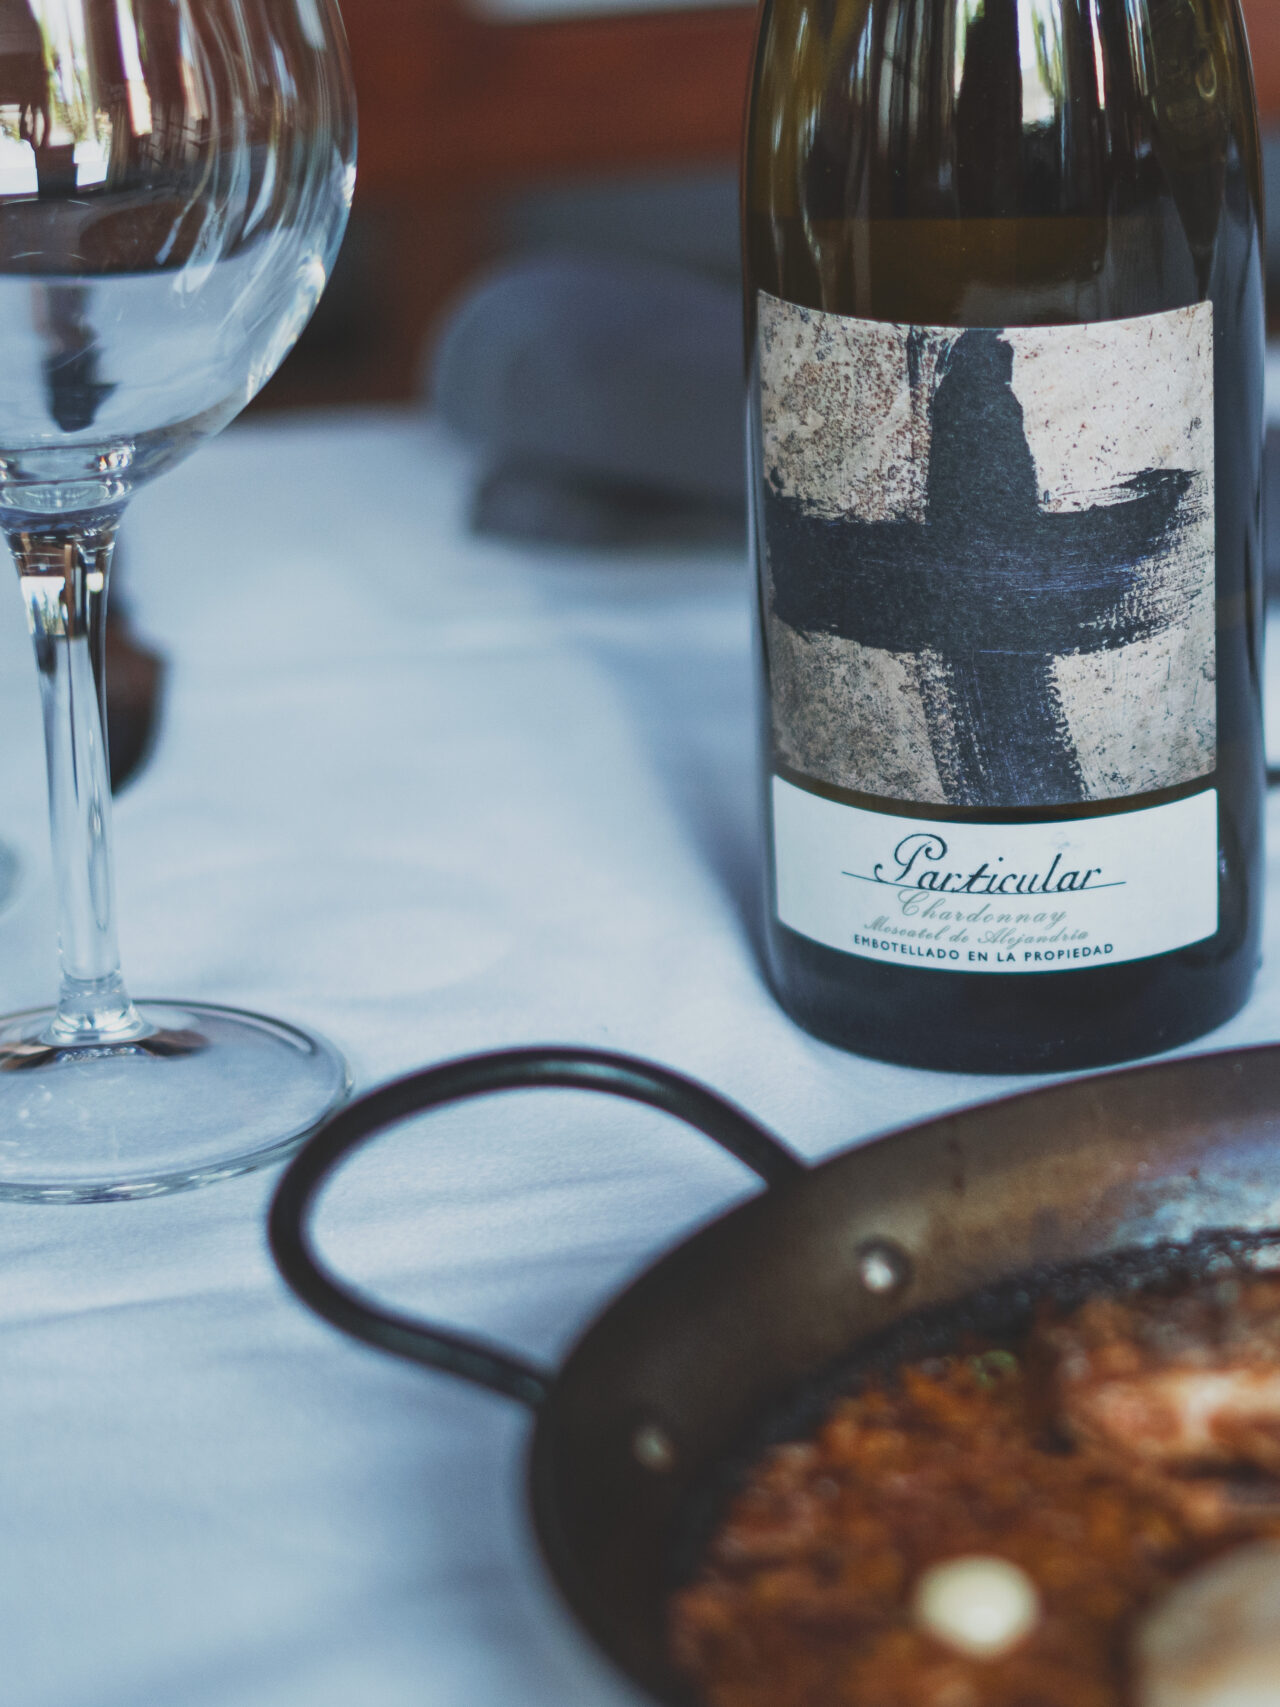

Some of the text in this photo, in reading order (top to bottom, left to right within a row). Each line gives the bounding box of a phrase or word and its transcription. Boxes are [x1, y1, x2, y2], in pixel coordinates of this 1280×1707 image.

[873, 833, 1102, 893] Particular
[897, 889, 1067, 927] Chardonnay
[864, 915, 949, 941] Moscatel
[949, 929, 969, 944] de
[854, 934, 1114, 962] EMBOTELLADO EN LA PROPIEDAD
